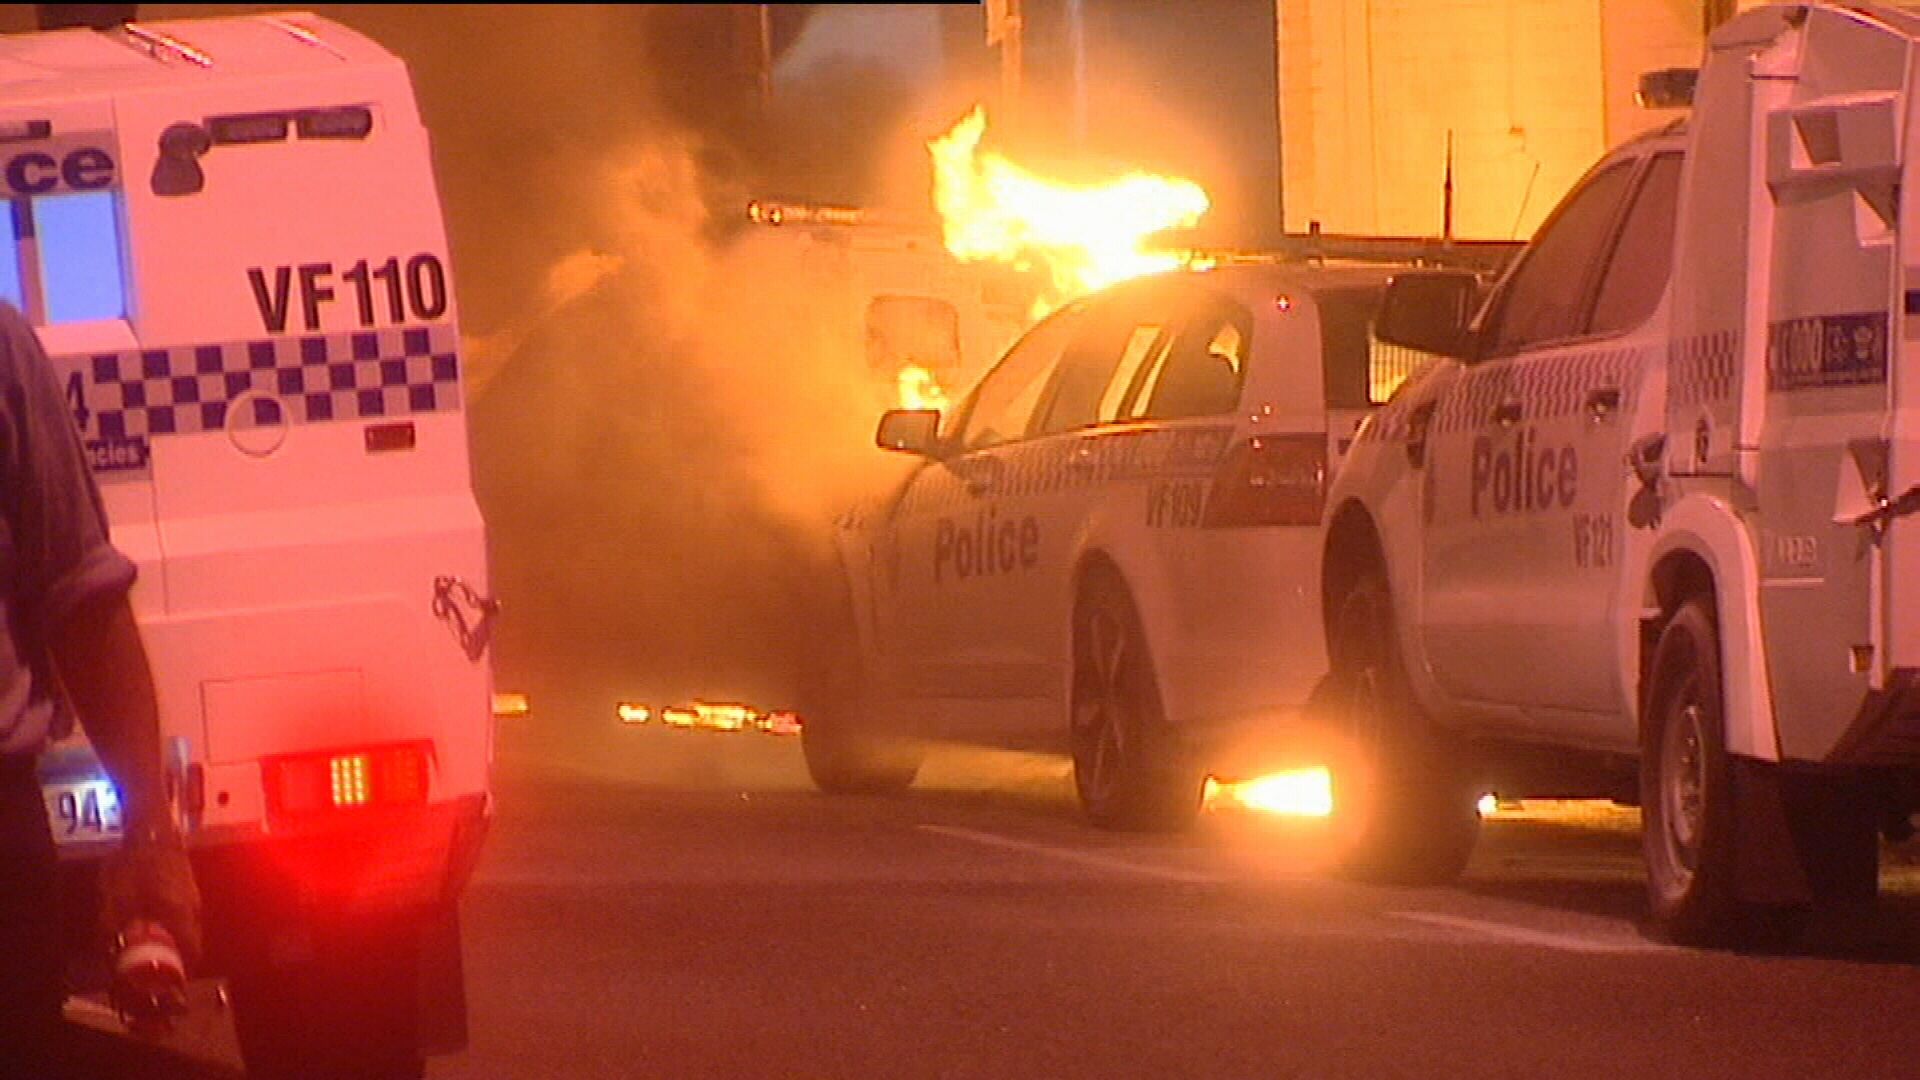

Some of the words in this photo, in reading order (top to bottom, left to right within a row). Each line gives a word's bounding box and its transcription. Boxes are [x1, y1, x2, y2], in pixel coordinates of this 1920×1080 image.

[6, 147, 114, 194] ce
[247, 253, 447, 334] VF110
[1472, 427, 1578, 516] Police
[934, 502, 1039, 583] Police
[1573, 512, 1613, 567] VF121
